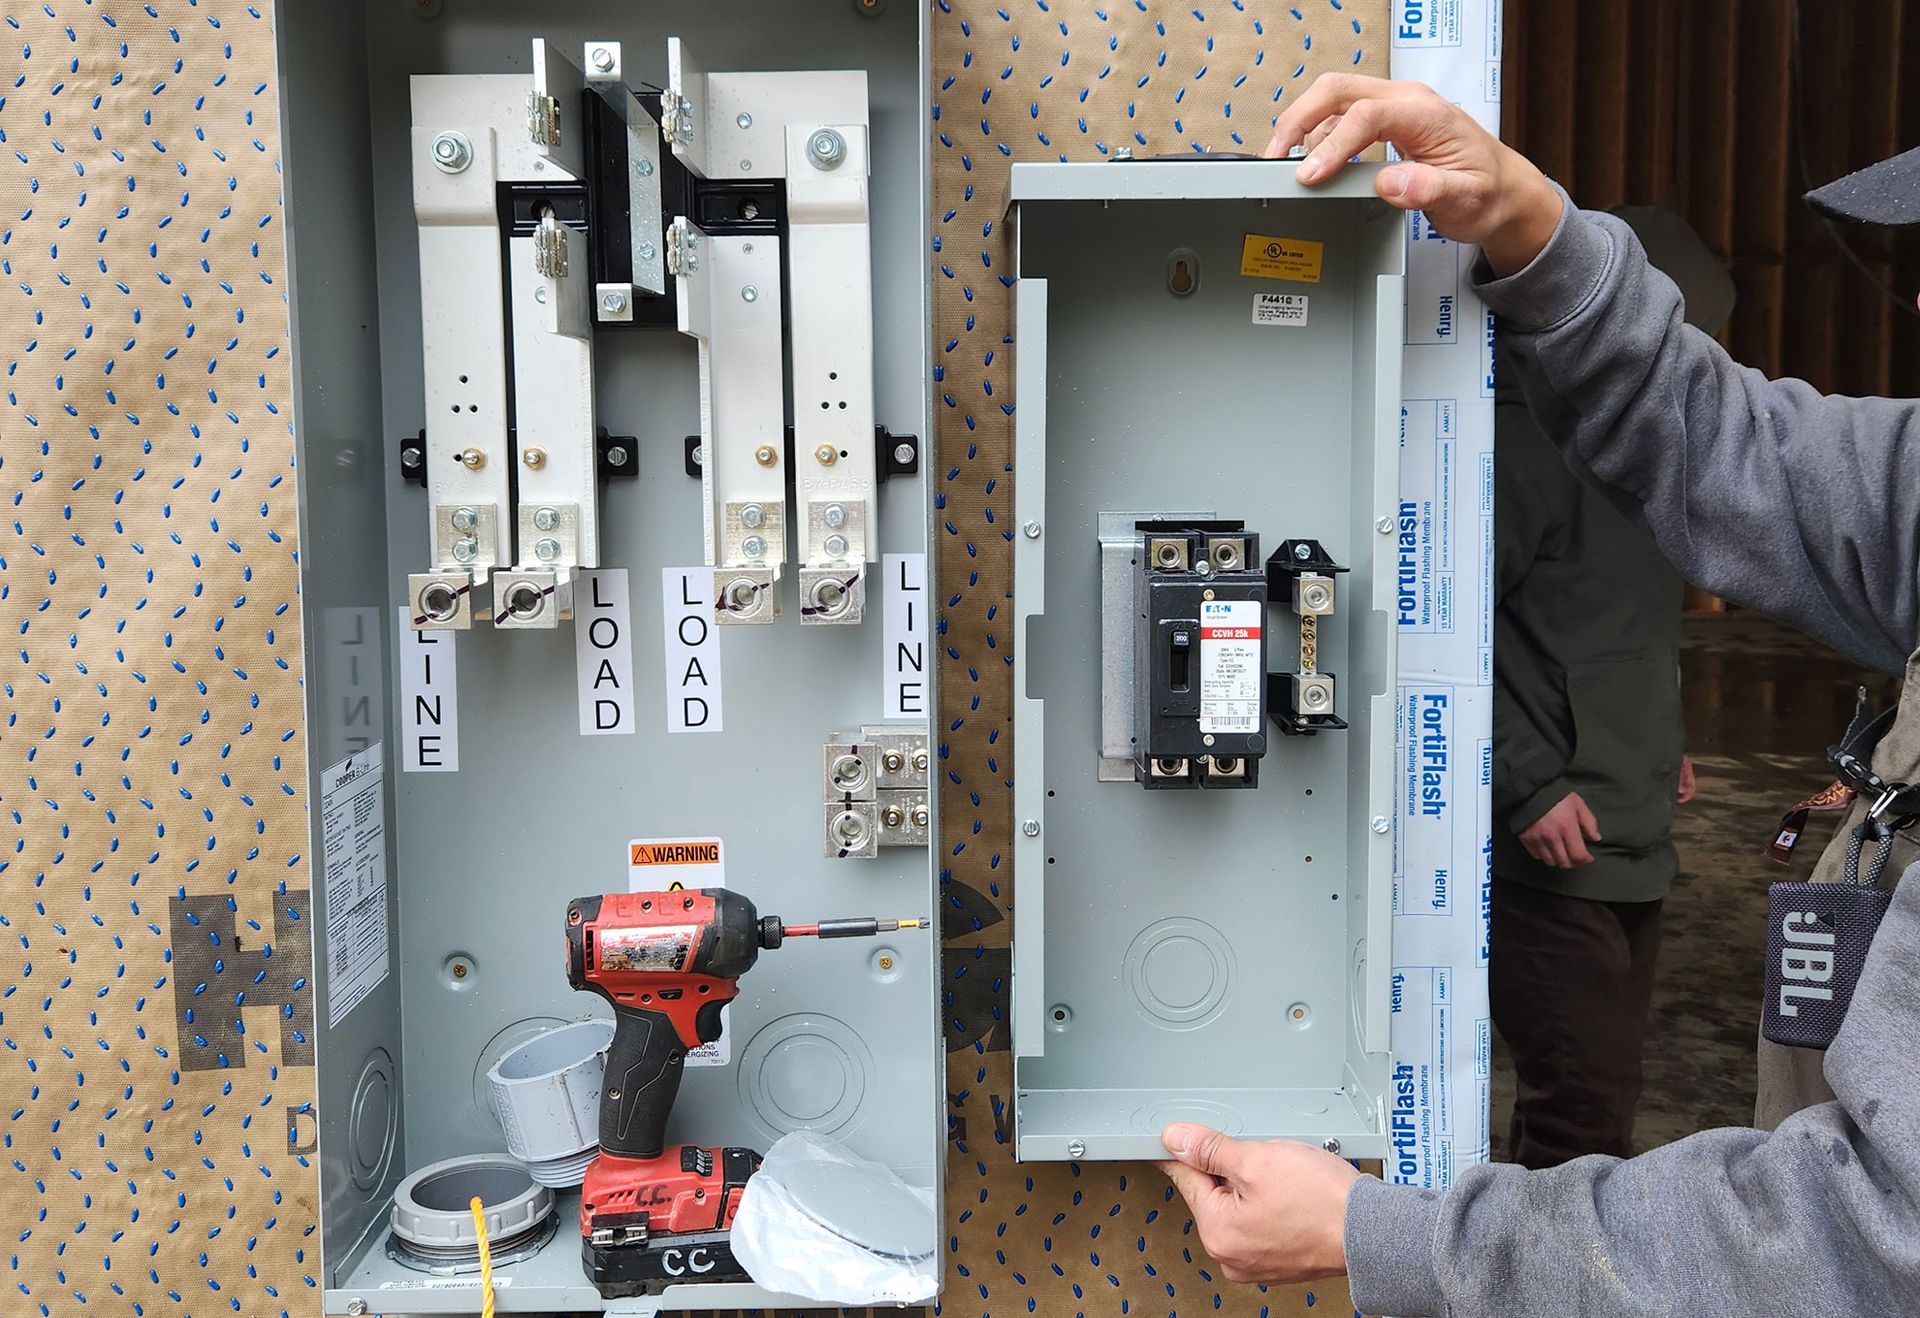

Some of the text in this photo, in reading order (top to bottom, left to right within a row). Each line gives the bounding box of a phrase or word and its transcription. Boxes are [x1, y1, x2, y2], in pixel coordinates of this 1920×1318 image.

[1422, 501, 1433, 625] Waterproof Flashing Membrane
[588, 576, 621, 730] LOAD
[678, 575, 710, 729] LOAD
[897, 560, 923, 714] LINE
[1212, 629, 1249, 638] CCVH 25k
[1407, 694, 1418, 817] Waterproof Flashing Membrane
[652, 844, 719, 863] WARNING
[1779, 911, 1836, 1017] JBL
[1420, 1064, 1432, 1190] Waterproof Flashing Membrane
[661, 1247, 717, 1277] CC
